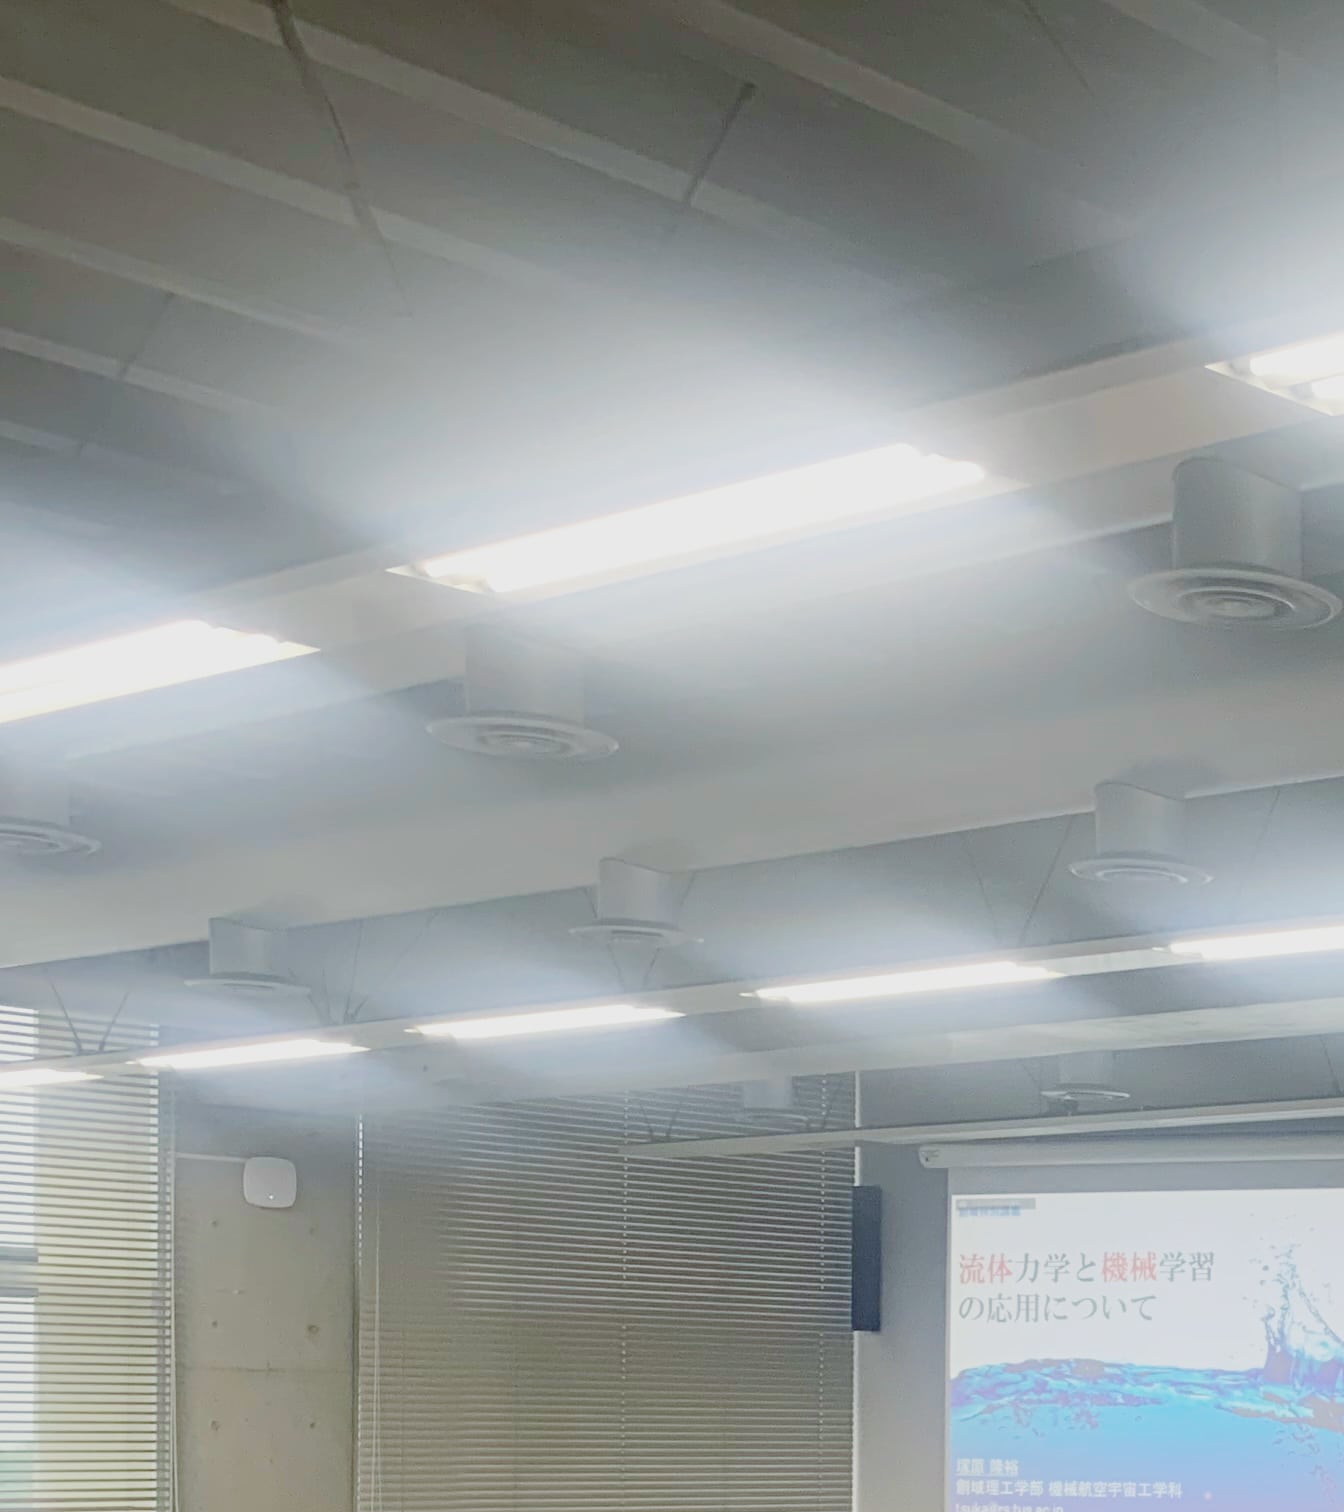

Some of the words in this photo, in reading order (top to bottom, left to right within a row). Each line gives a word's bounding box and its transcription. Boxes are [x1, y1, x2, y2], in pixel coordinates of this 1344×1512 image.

[959, 1251, 1215, 1285] 流体力学と機械学習
[958, 1292, 1157, 1323] の応用について
